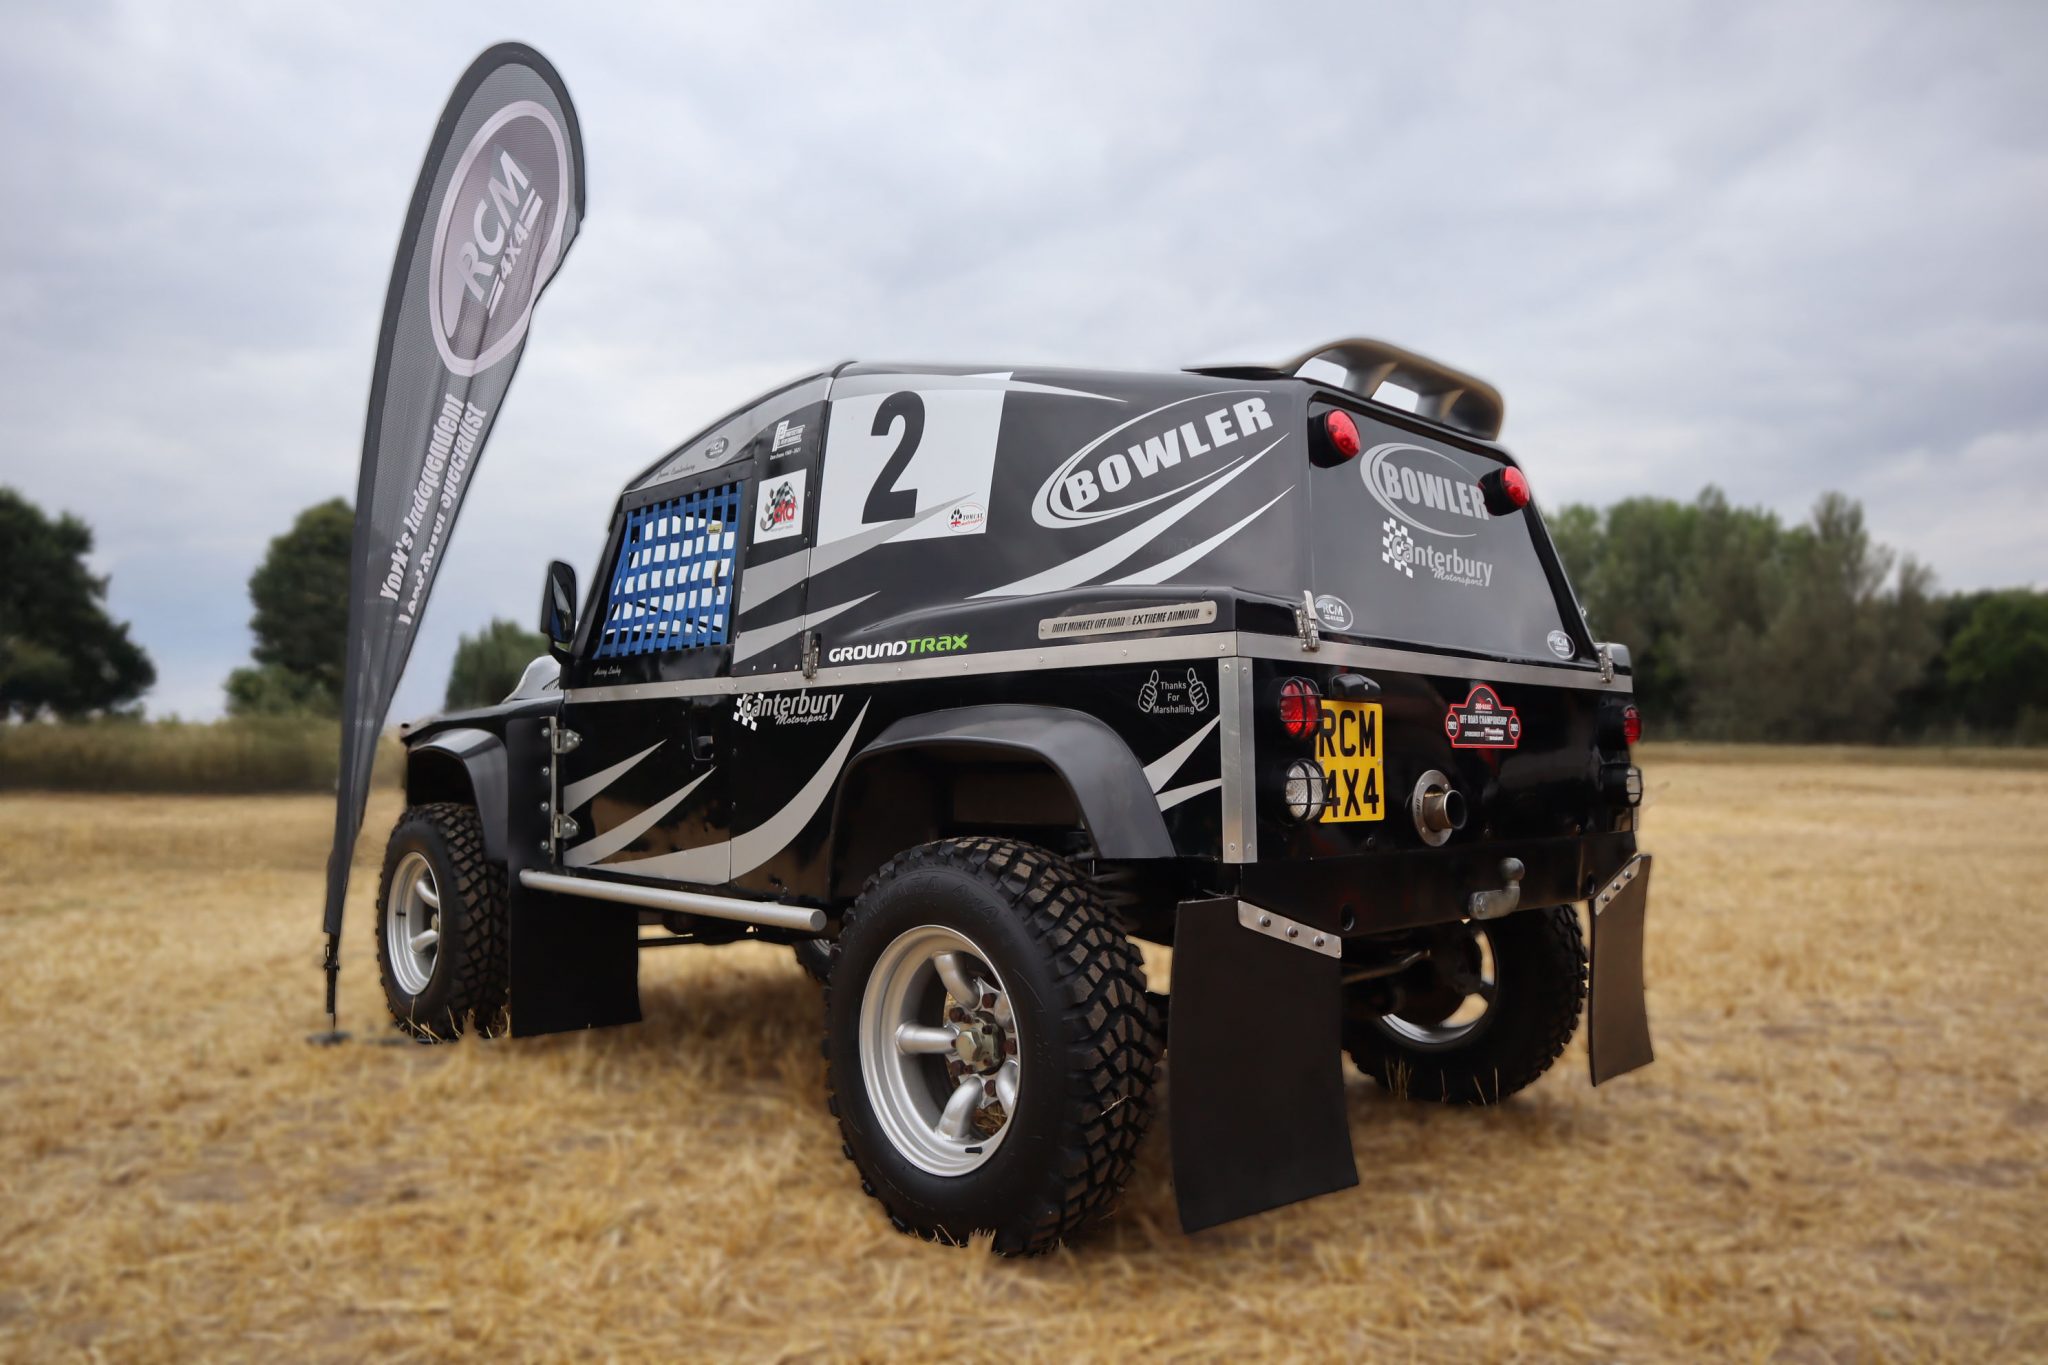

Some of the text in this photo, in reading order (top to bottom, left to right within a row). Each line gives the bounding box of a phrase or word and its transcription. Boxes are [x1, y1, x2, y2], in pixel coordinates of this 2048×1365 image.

[457, 151, 529, 301] RCM
[861, 390, 926, 525] 2
[1064, 397, 1274, 512] BOWLER
[380, 393, 466, 601] York's Independent
[1381, 460, 1490, 520] BOWLER
[1391, 535, 1493, 587] Canterbury
[1431, 566, 1484, 586] Motorsport
[1051, 622, 1068, 633] DIRT
[1067, 619, 1095, 631] MONKEY
[1094, 617, 1107, 629] OFF
[1132, 611, 1168, 626] EXTREME
[1168, 608, 1200, 622] ARMOUR
[1322, 602, 1344, 617] RCM
[741, 689, 844, 721] Canterbury
[1160, 681, 1187, 690] Thanks
[1167, 692, 1180, 702] For
[775, 713, 828, 725] Motorsport
[1152, 704, 1195, 715] Marshalling
[1319, 708, 1376, 757] RCM
[1323, 768, 1380, 818] 4X4
